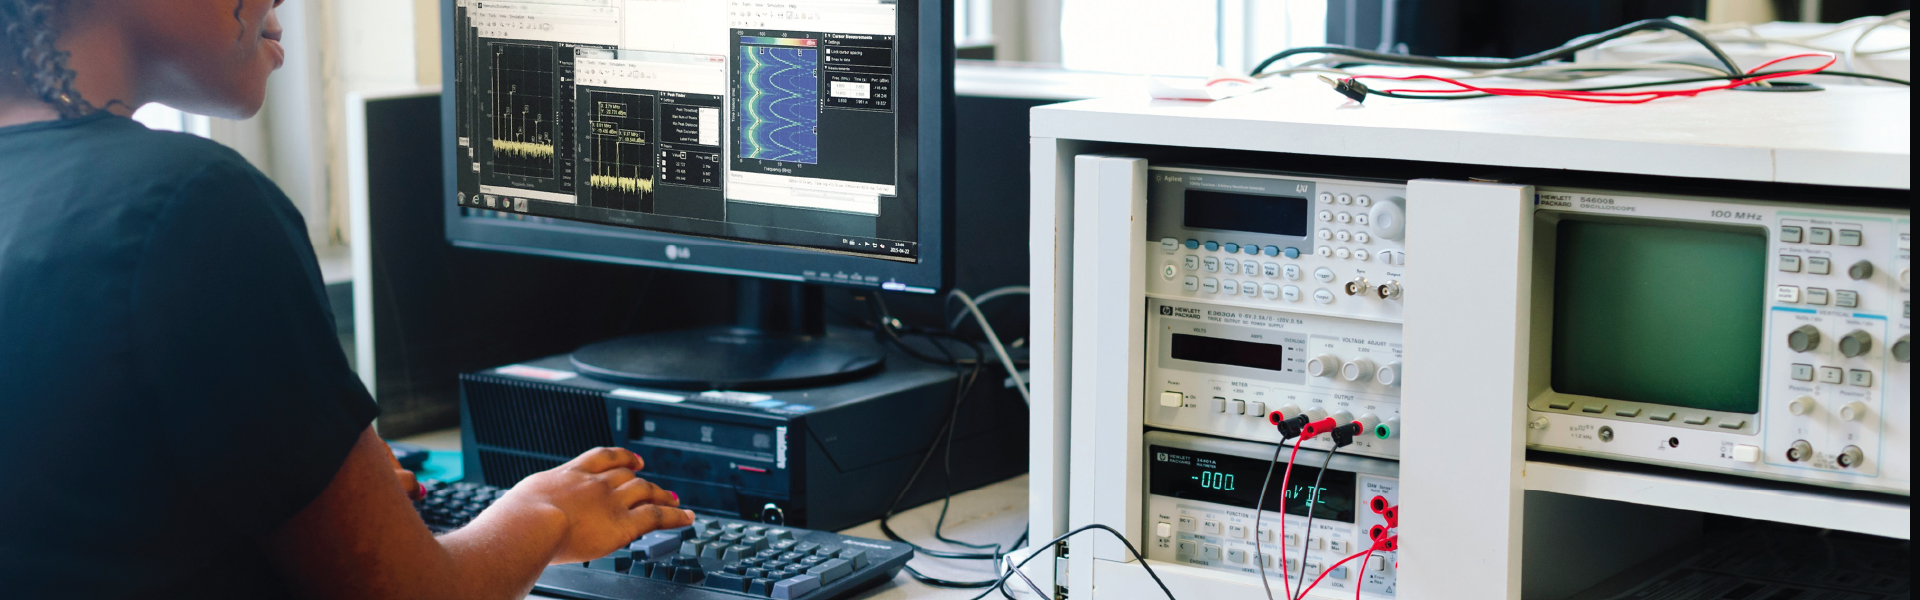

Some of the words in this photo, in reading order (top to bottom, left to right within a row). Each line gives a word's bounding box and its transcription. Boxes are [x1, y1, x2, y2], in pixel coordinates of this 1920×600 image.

[1296, 184, 1308, 193] LXI
[1580, 196, 1614, 205] 54600B
[1580, 203, 1636, 212] OSCILLOSCOPE
[1711, 210, 1732, 218] 100
[1735, 211, 1762, 221] MHz
[678, 247, 690, 258] LG
